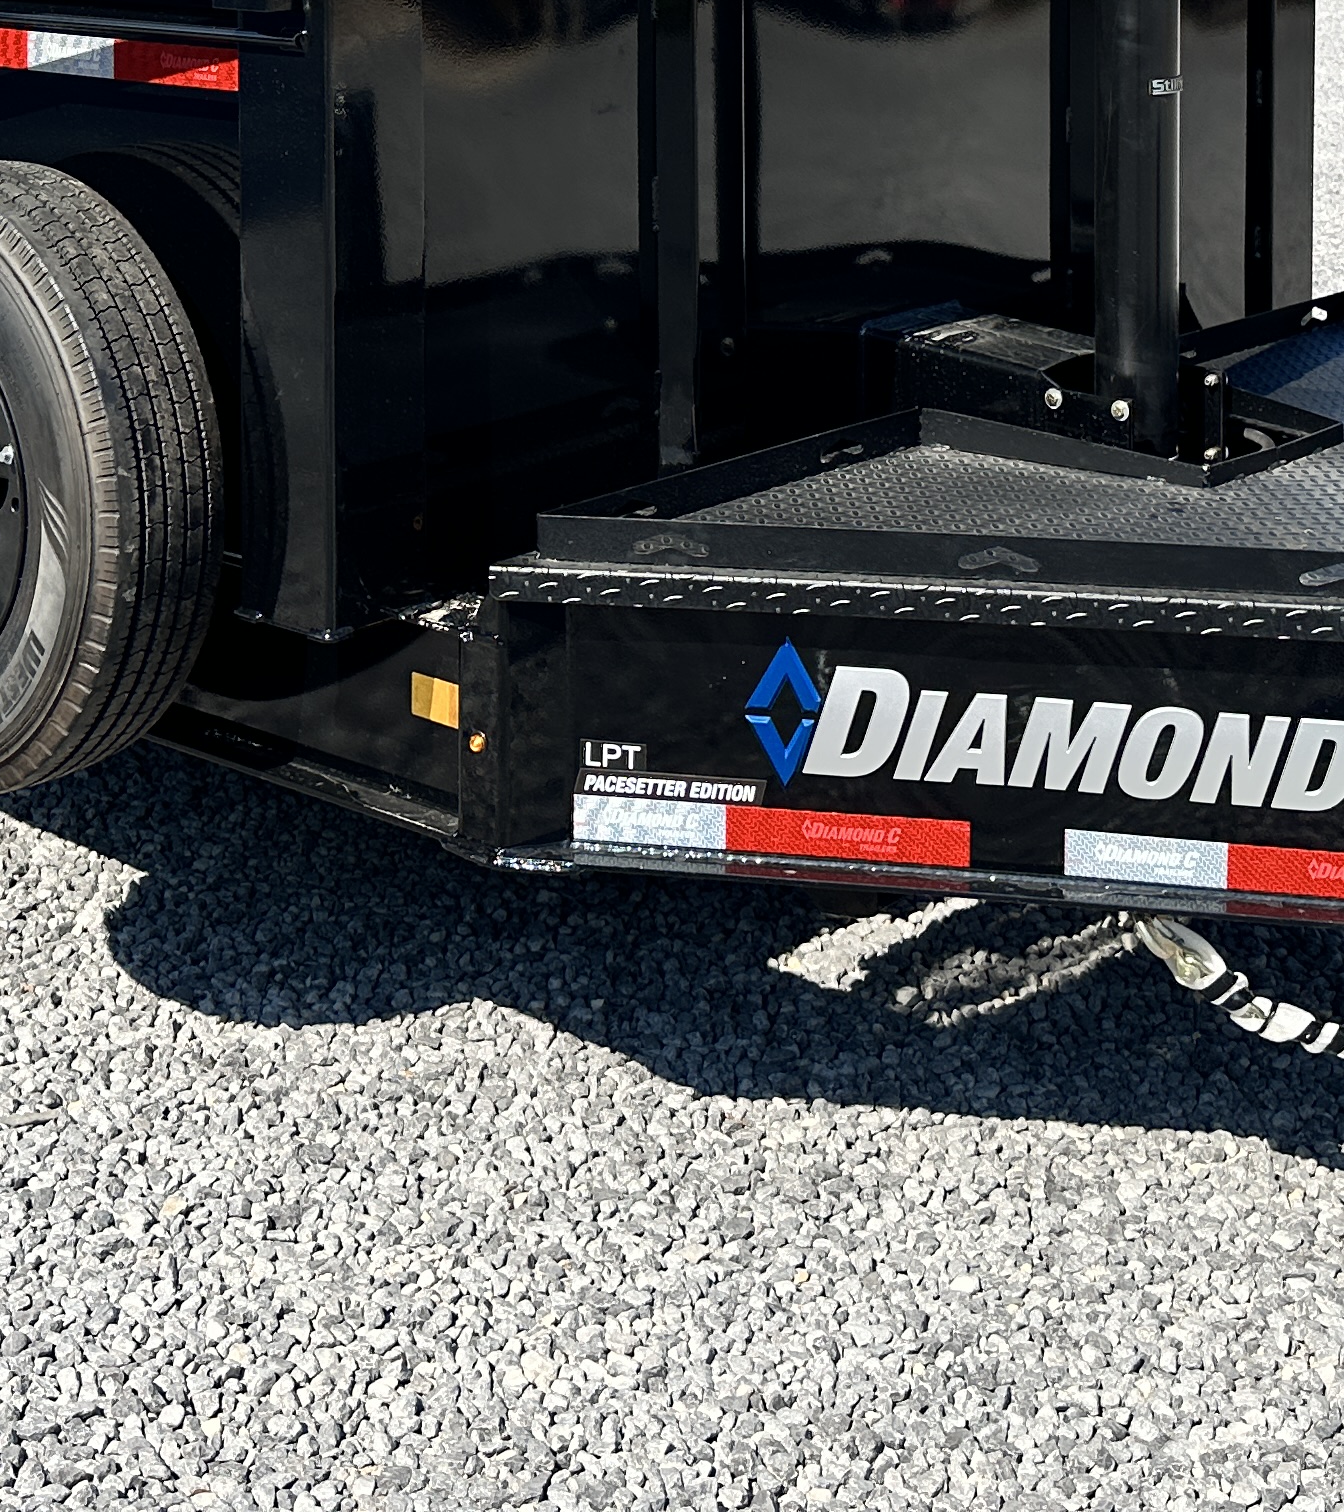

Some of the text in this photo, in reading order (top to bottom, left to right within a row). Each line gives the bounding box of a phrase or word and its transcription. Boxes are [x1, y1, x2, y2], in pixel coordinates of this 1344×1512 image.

[584, 741, 642, 770] LPT
[583, 774, 756, 803] PACESETTER EDITION
[811, 821, 902, 844] DIAMOND C
